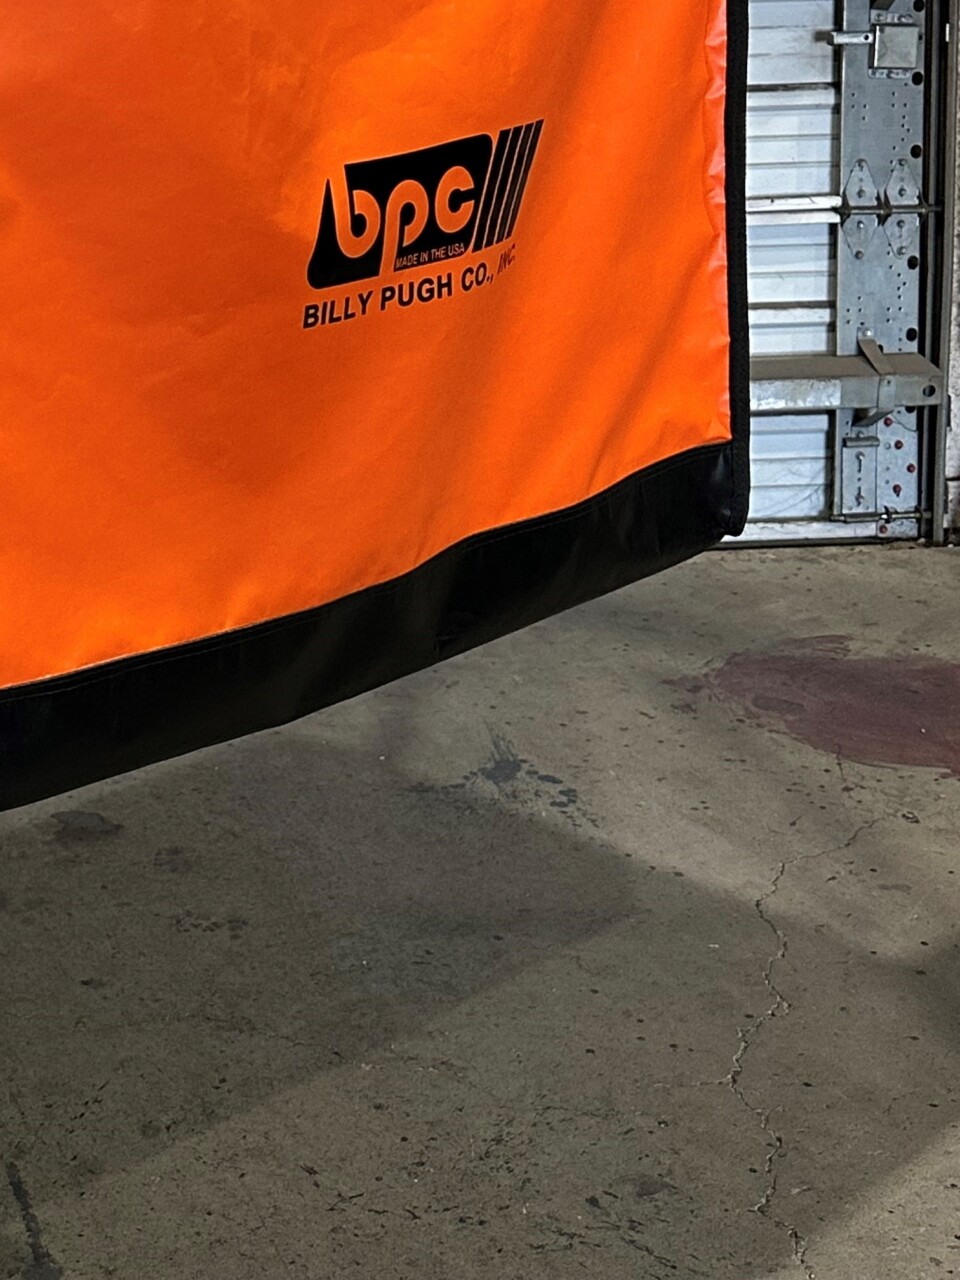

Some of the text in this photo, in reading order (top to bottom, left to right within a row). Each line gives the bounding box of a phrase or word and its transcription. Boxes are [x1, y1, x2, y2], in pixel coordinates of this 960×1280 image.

[395, 242, 465, 269] MADE IN THE USA
[303, 291, 373, 329] BILLY
[380, 273, 452, 311] PUGH
[461, 262, 494, 293] CO.,
